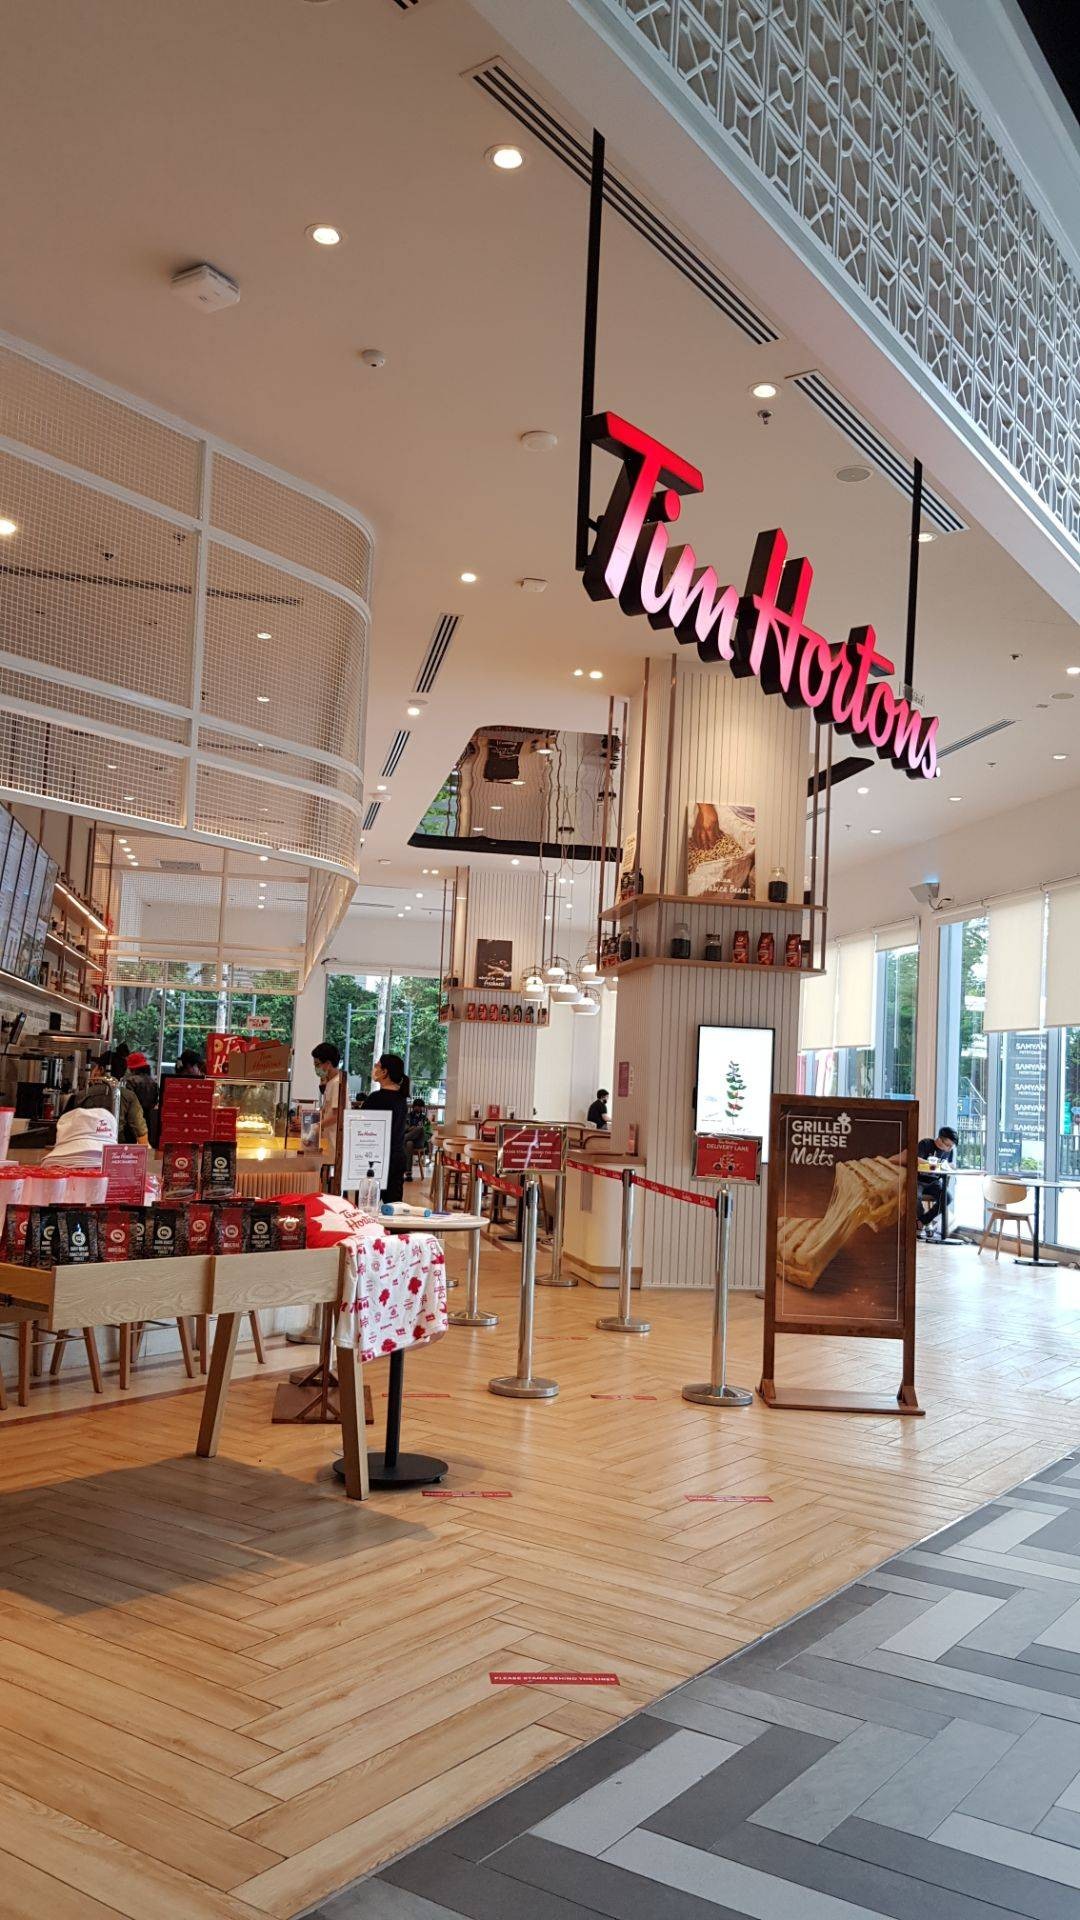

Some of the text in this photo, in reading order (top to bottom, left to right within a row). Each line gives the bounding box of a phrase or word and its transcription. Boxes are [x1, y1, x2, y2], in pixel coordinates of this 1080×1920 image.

[598, 410, 941, 780] Tim Hortons
[1015, 1042, 1047, 1051] SAMYAN
[1014, 1062, 1046, 1071] SAMYAN
[1014, 1083, 1046, 1092] SAMYAN
[1014, 1103, 1046, 1112] SAMYAN
[792, 1120, 852, 1135] GRILLED
[1013, 1123, 1045, 1133] SAMYAN
[791, 1133, 848, 1148] CHEESE
[706, 1143, 733, 1152] DELIVERY
[790, 1146, 835, 1167] Melts
